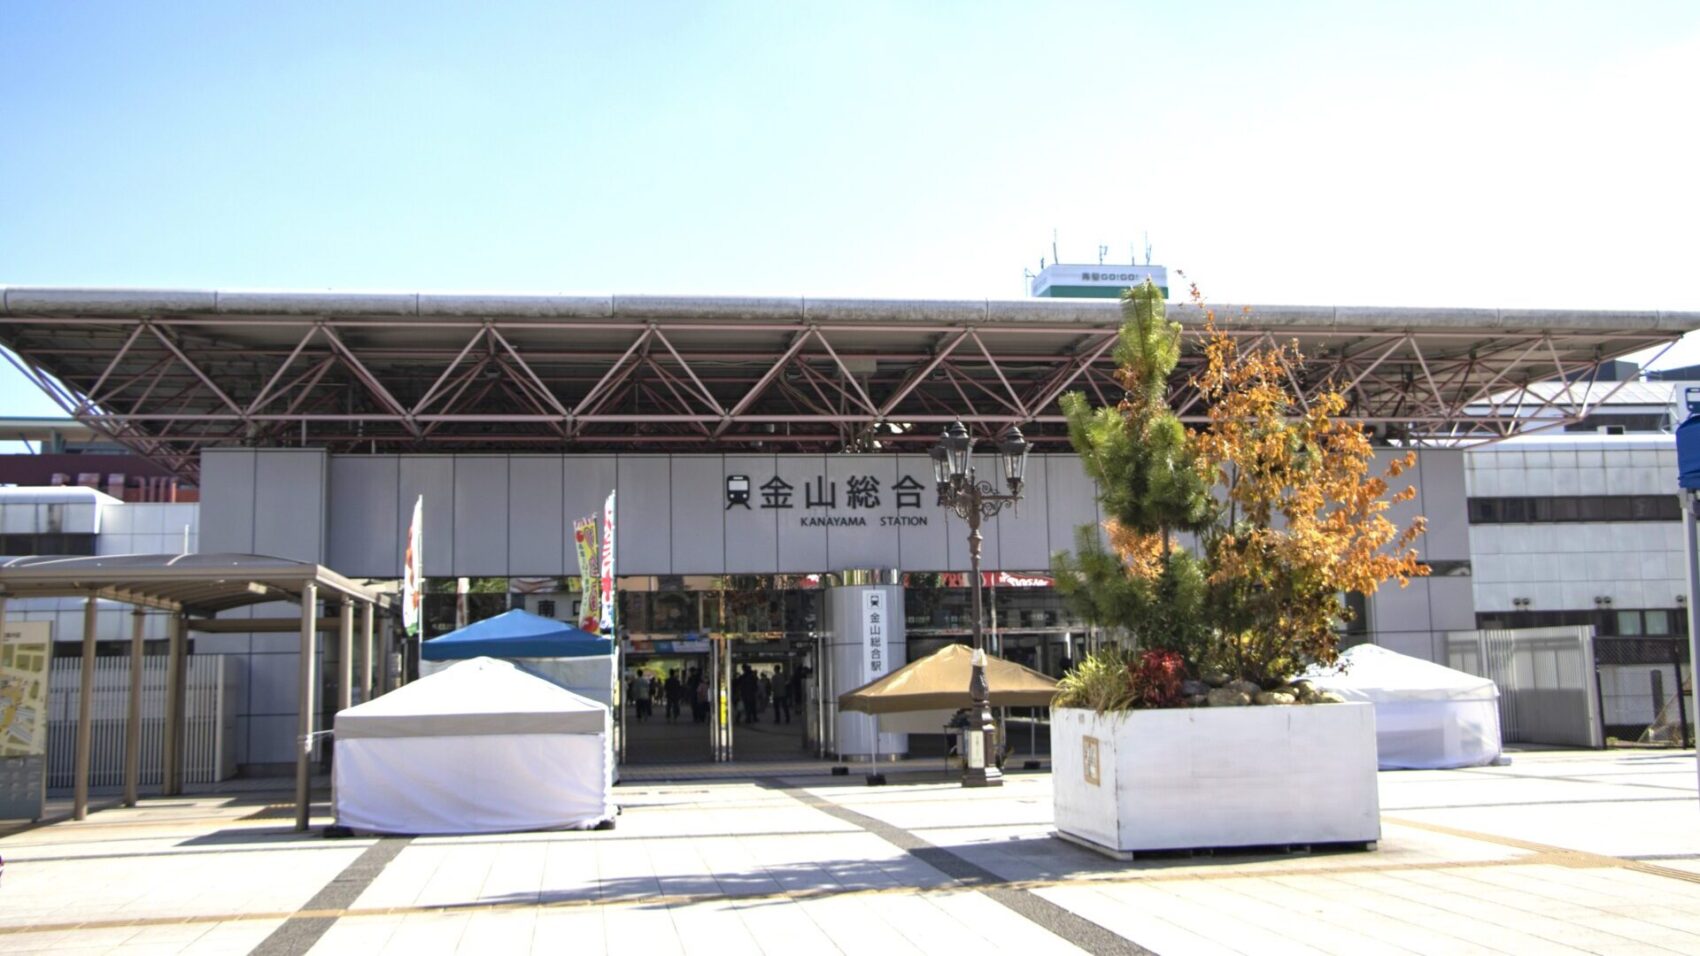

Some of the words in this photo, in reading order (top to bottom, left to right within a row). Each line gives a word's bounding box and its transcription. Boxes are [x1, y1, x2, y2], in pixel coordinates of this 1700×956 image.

[760, 475, 952, 510] 金山総合
[801, 517, 867, 527] KANAYAMA
[880, 517, 928, 527] STATION
[870, 612, 882, 672] 金山総合駅
